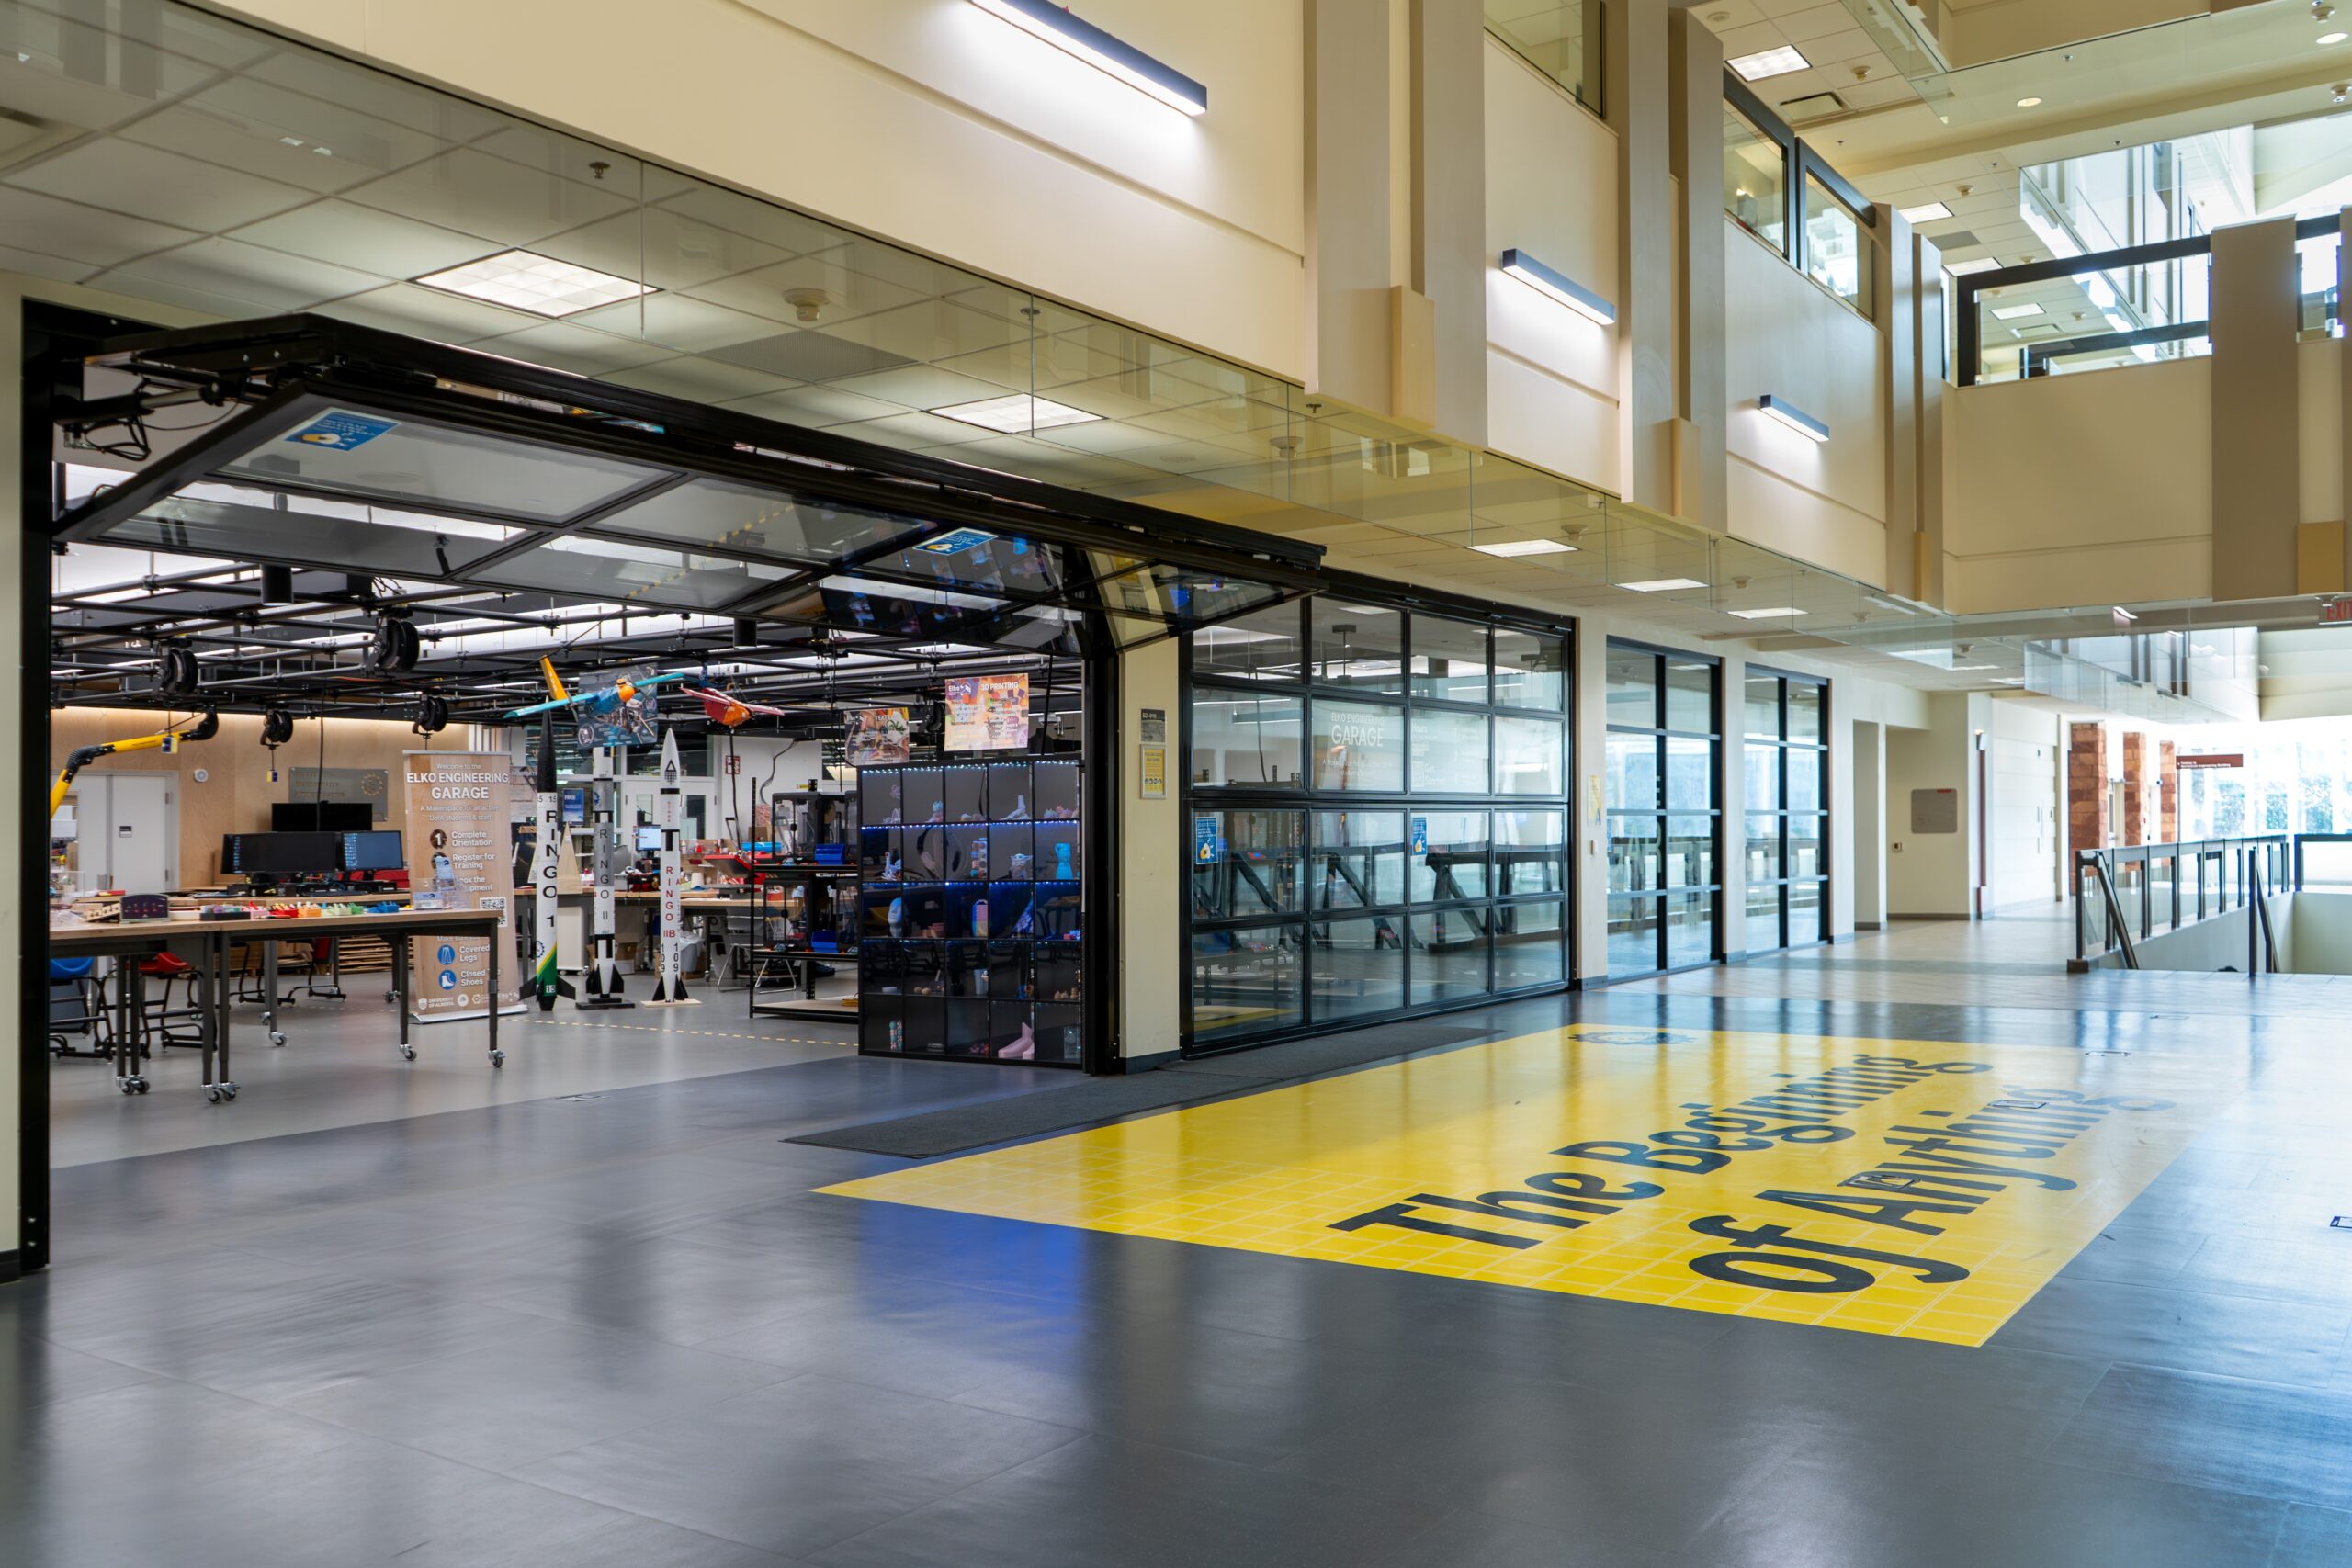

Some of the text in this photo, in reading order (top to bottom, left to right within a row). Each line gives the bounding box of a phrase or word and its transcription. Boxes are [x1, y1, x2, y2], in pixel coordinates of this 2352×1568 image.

[989, 682, 1019, 691] PRINTING
[1331, 724, 1385, 747] GARAGE
[406, 773, 437, 784] ELKO
[438, 773, 510, 784] ENGINEERING
[431, 786, 490, 800] GARAGE
[435, 832, 442, 846] 1
[451, 830, 487, 840] Complete
[451, 838, 493, 847] Orientation
[452, 852, 495, 863] Register for
[543, 809, 558, 898] RINGO
[452, 862, 484, 870] Training
[599, 829, 610, 899] RINGO
[665, 866, 673, 922] RINGO
[459, 943, 491, 953] Covered
[459, 954, 478, 963] Legs
[460, 969, 486, 977] Closed
[460, 977, 484, 987] Shoes
[1325, 1053, 1994, 1250] The Beginning
[1688, 1085, 2177, 1294] of Anything
